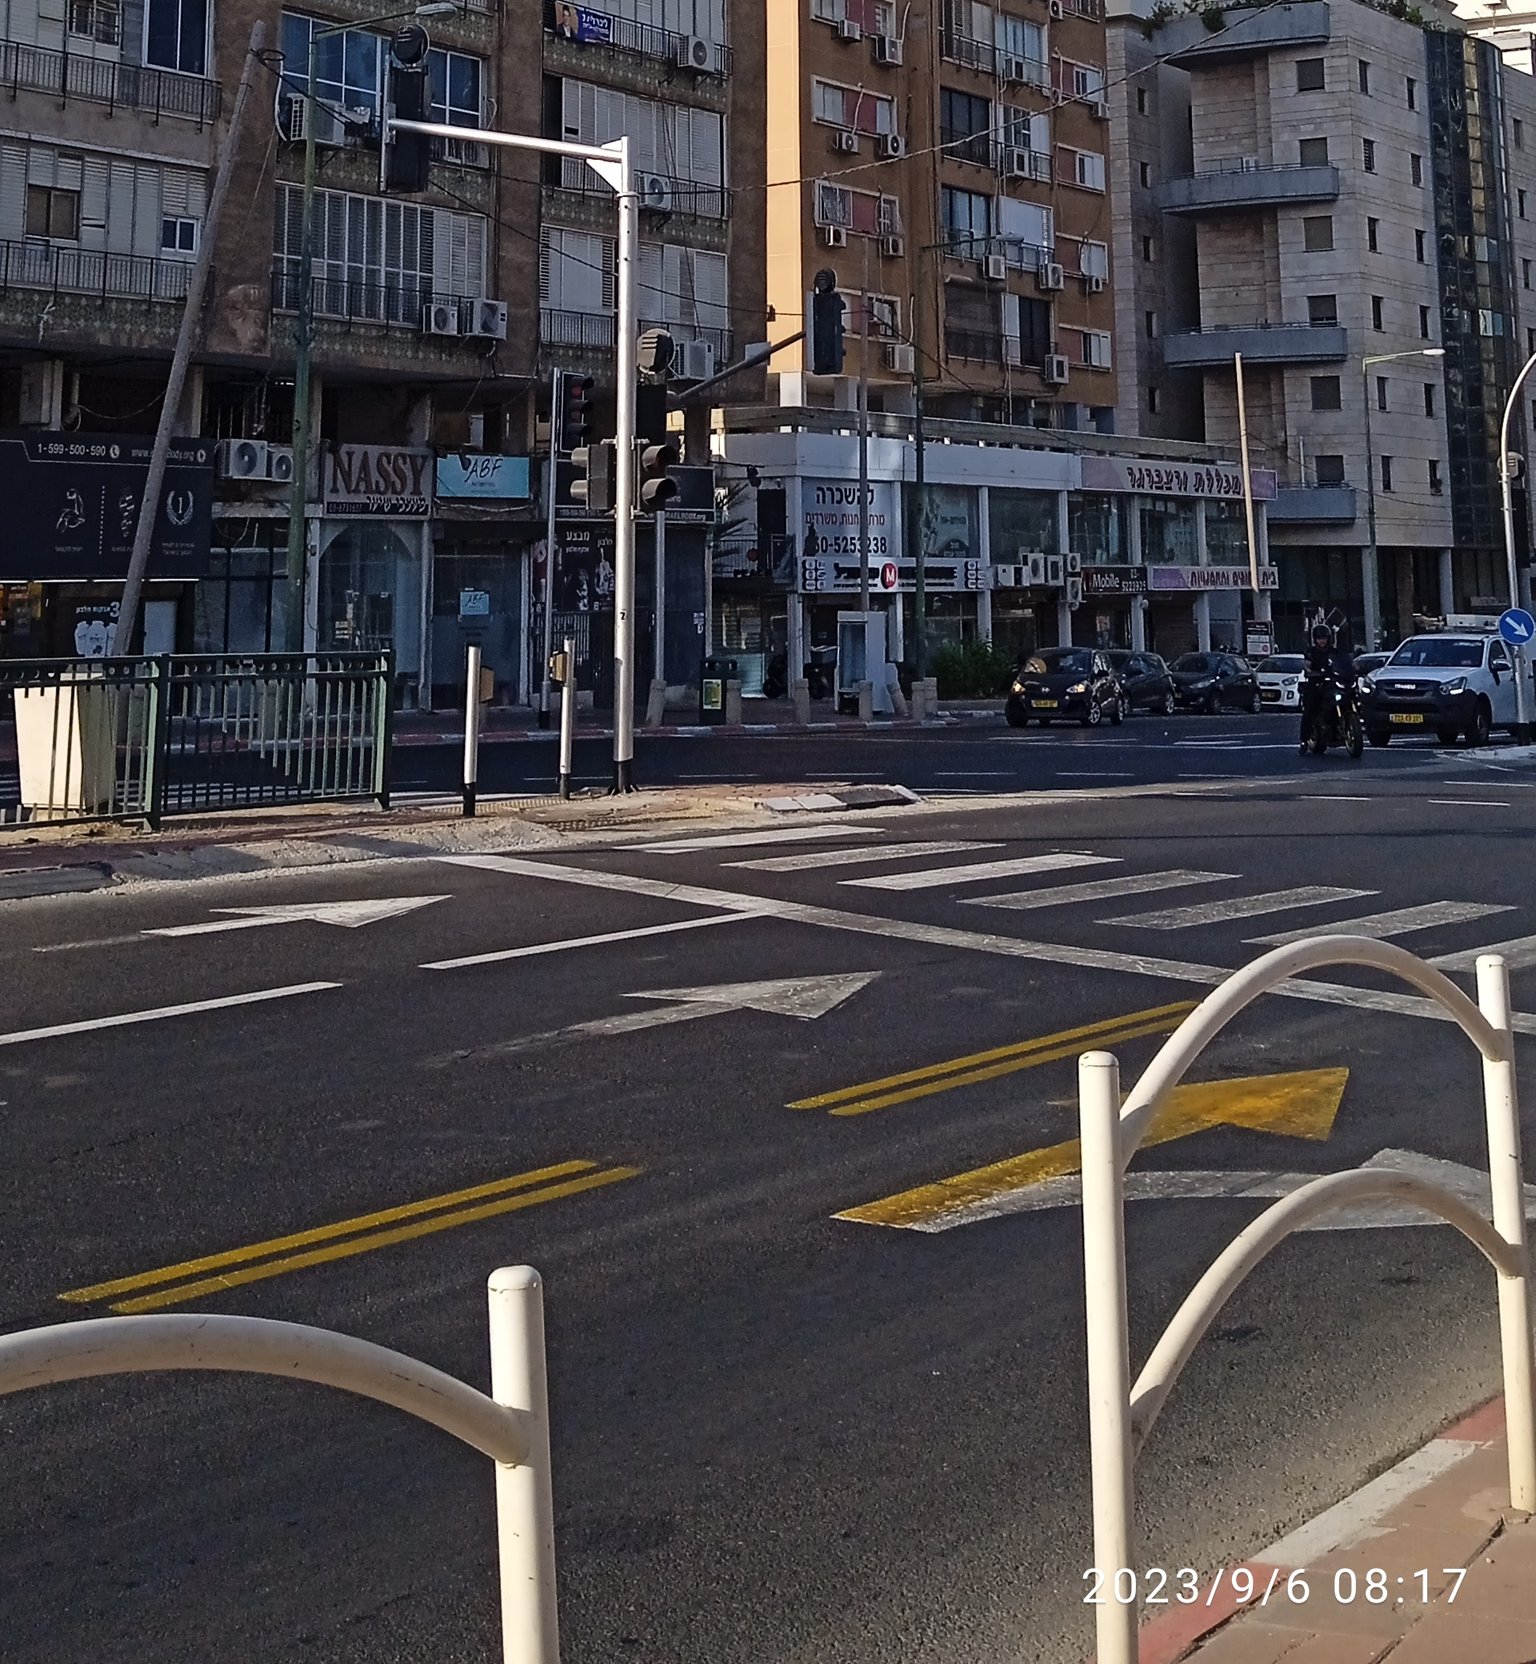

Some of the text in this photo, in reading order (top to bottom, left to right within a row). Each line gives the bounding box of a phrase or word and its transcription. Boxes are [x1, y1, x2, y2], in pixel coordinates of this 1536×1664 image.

[37, 443, 106, 457] 1-599-500-590
[329, 450, 429, 496] NASSY
[464, 458, 504, 483] ABF
[1194, 467, 1242, 496] מכללת
[868, 513, 885, 526] מרת
[565, 531, 590, 542] מבצע
[812, 536, 887, 554] 0-525238
[109, 601, 120, 617] 3
